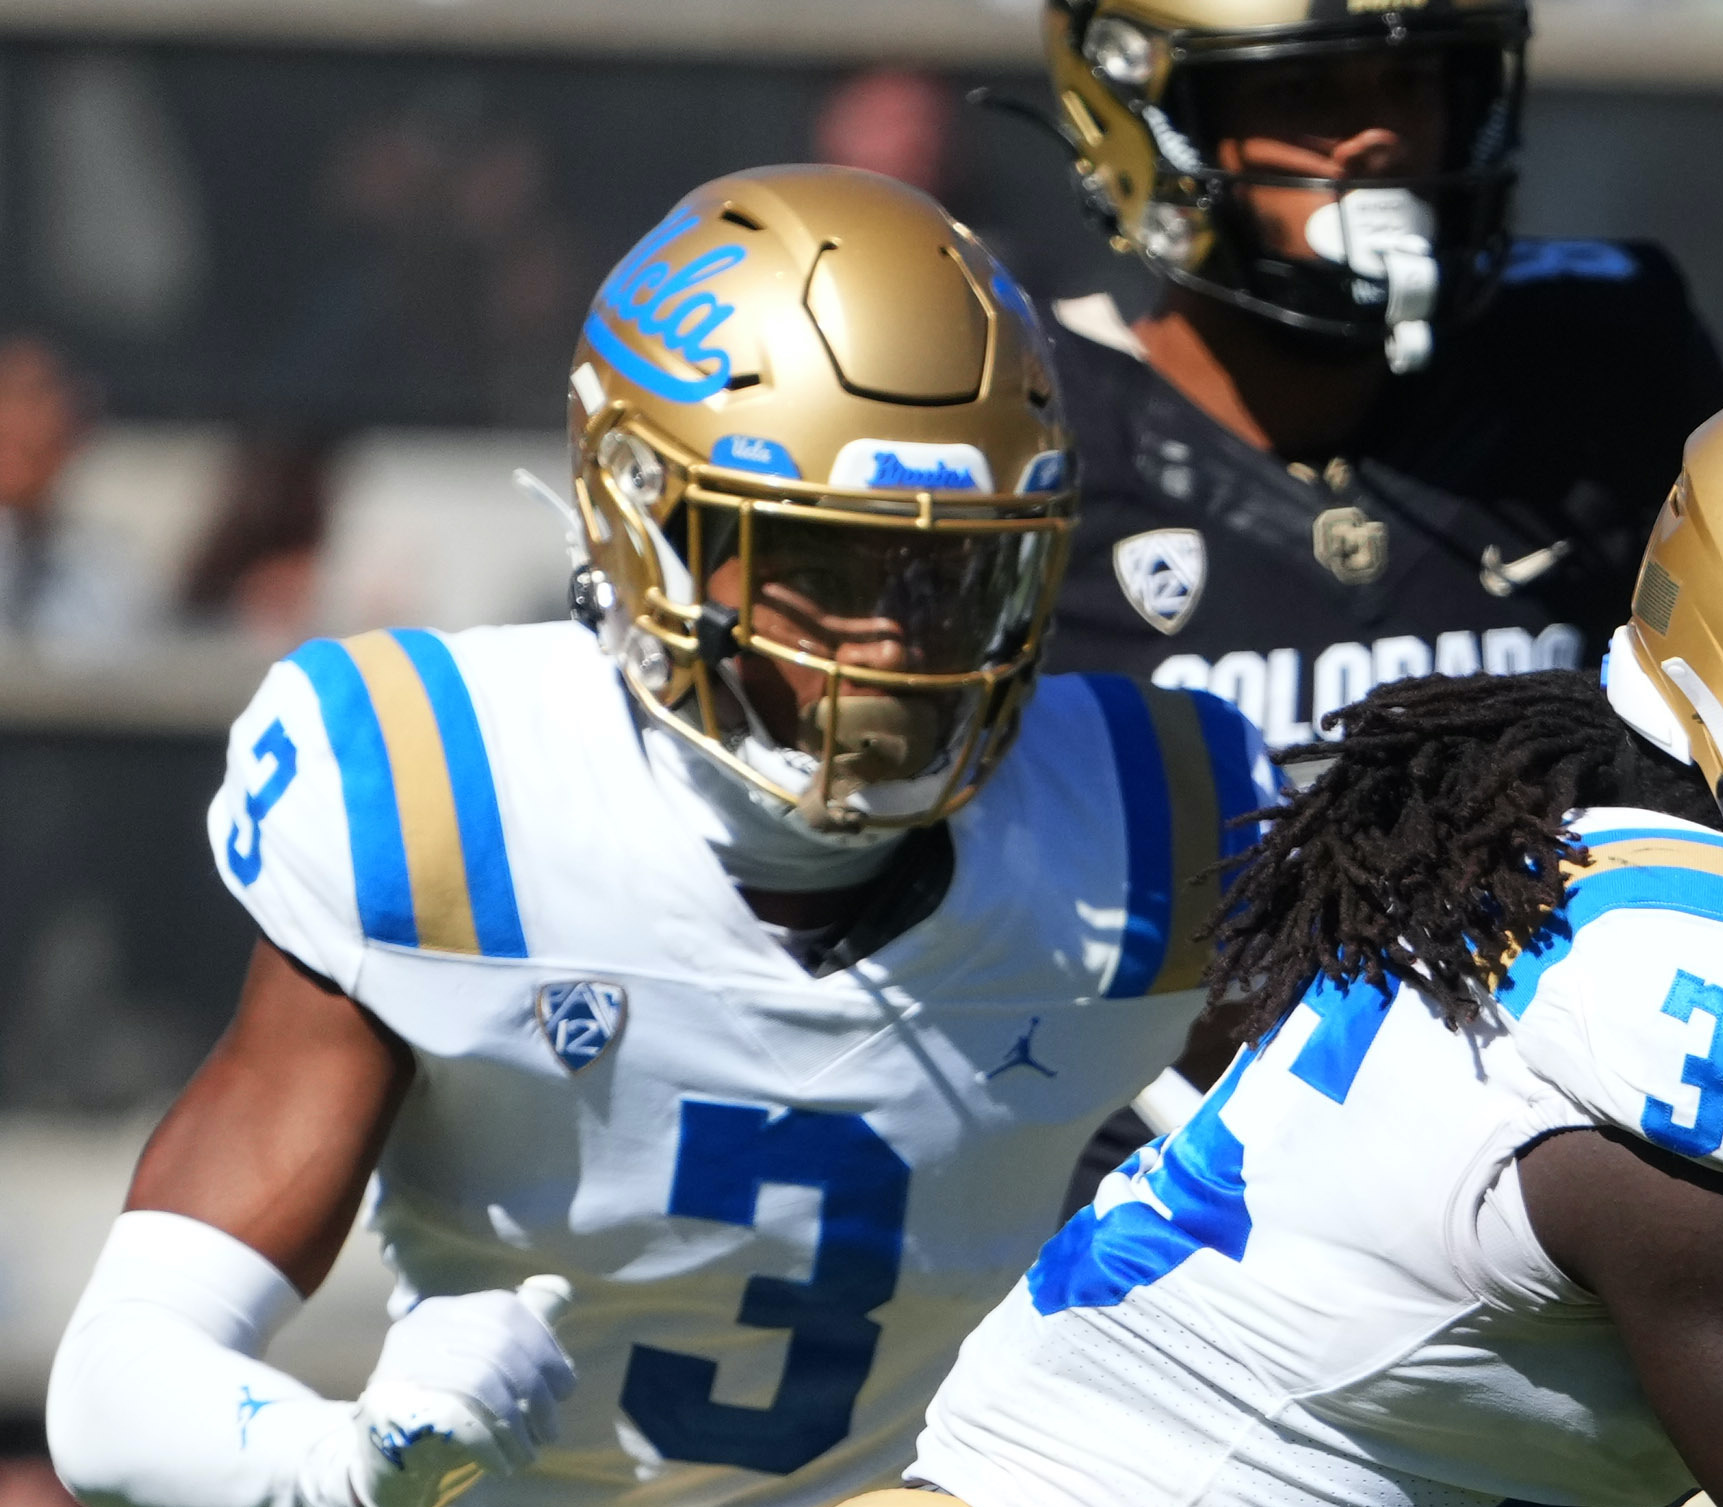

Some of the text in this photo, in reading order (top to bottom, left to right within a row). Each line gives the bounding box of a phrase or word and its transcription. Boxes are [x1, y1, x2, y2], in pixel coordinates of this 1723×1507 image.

[227, 718, 300, 888] 3
[555, 1018, 600, 1056] 12
[619, 1096, 912, 1476] 3
